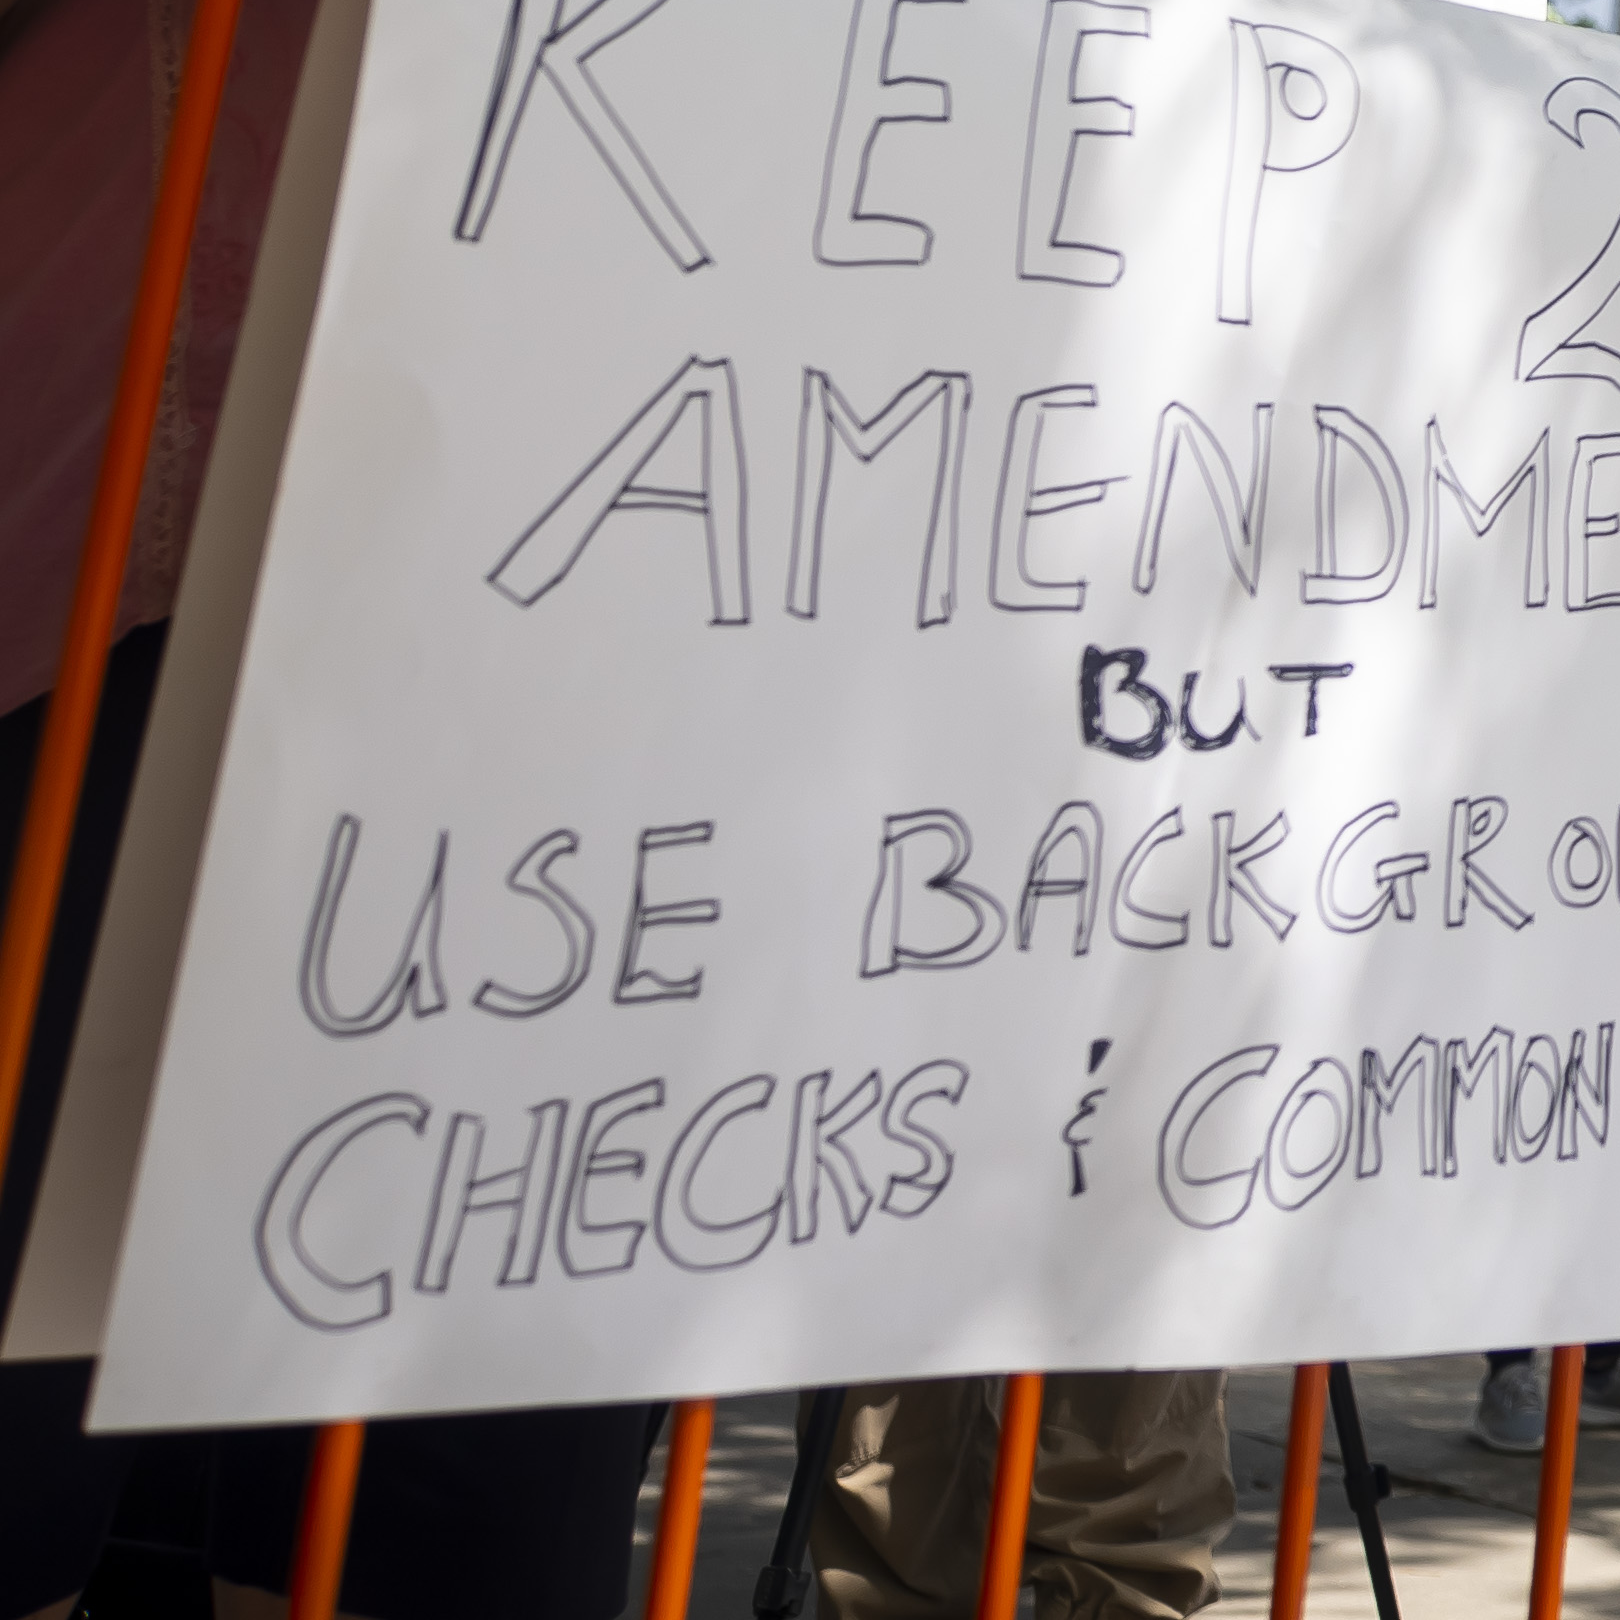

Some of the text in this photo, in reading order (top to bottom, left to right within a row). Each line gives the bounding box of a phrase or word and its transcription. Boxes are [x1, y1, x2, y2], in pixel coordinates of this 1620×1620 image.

[1078, 644, 1355, 761] BUT
[298, 811, 720, 1038] USE
[255, 1057, 969, 1332] CHECKS
[1158, 1021, 1614, 1230] COMMON
